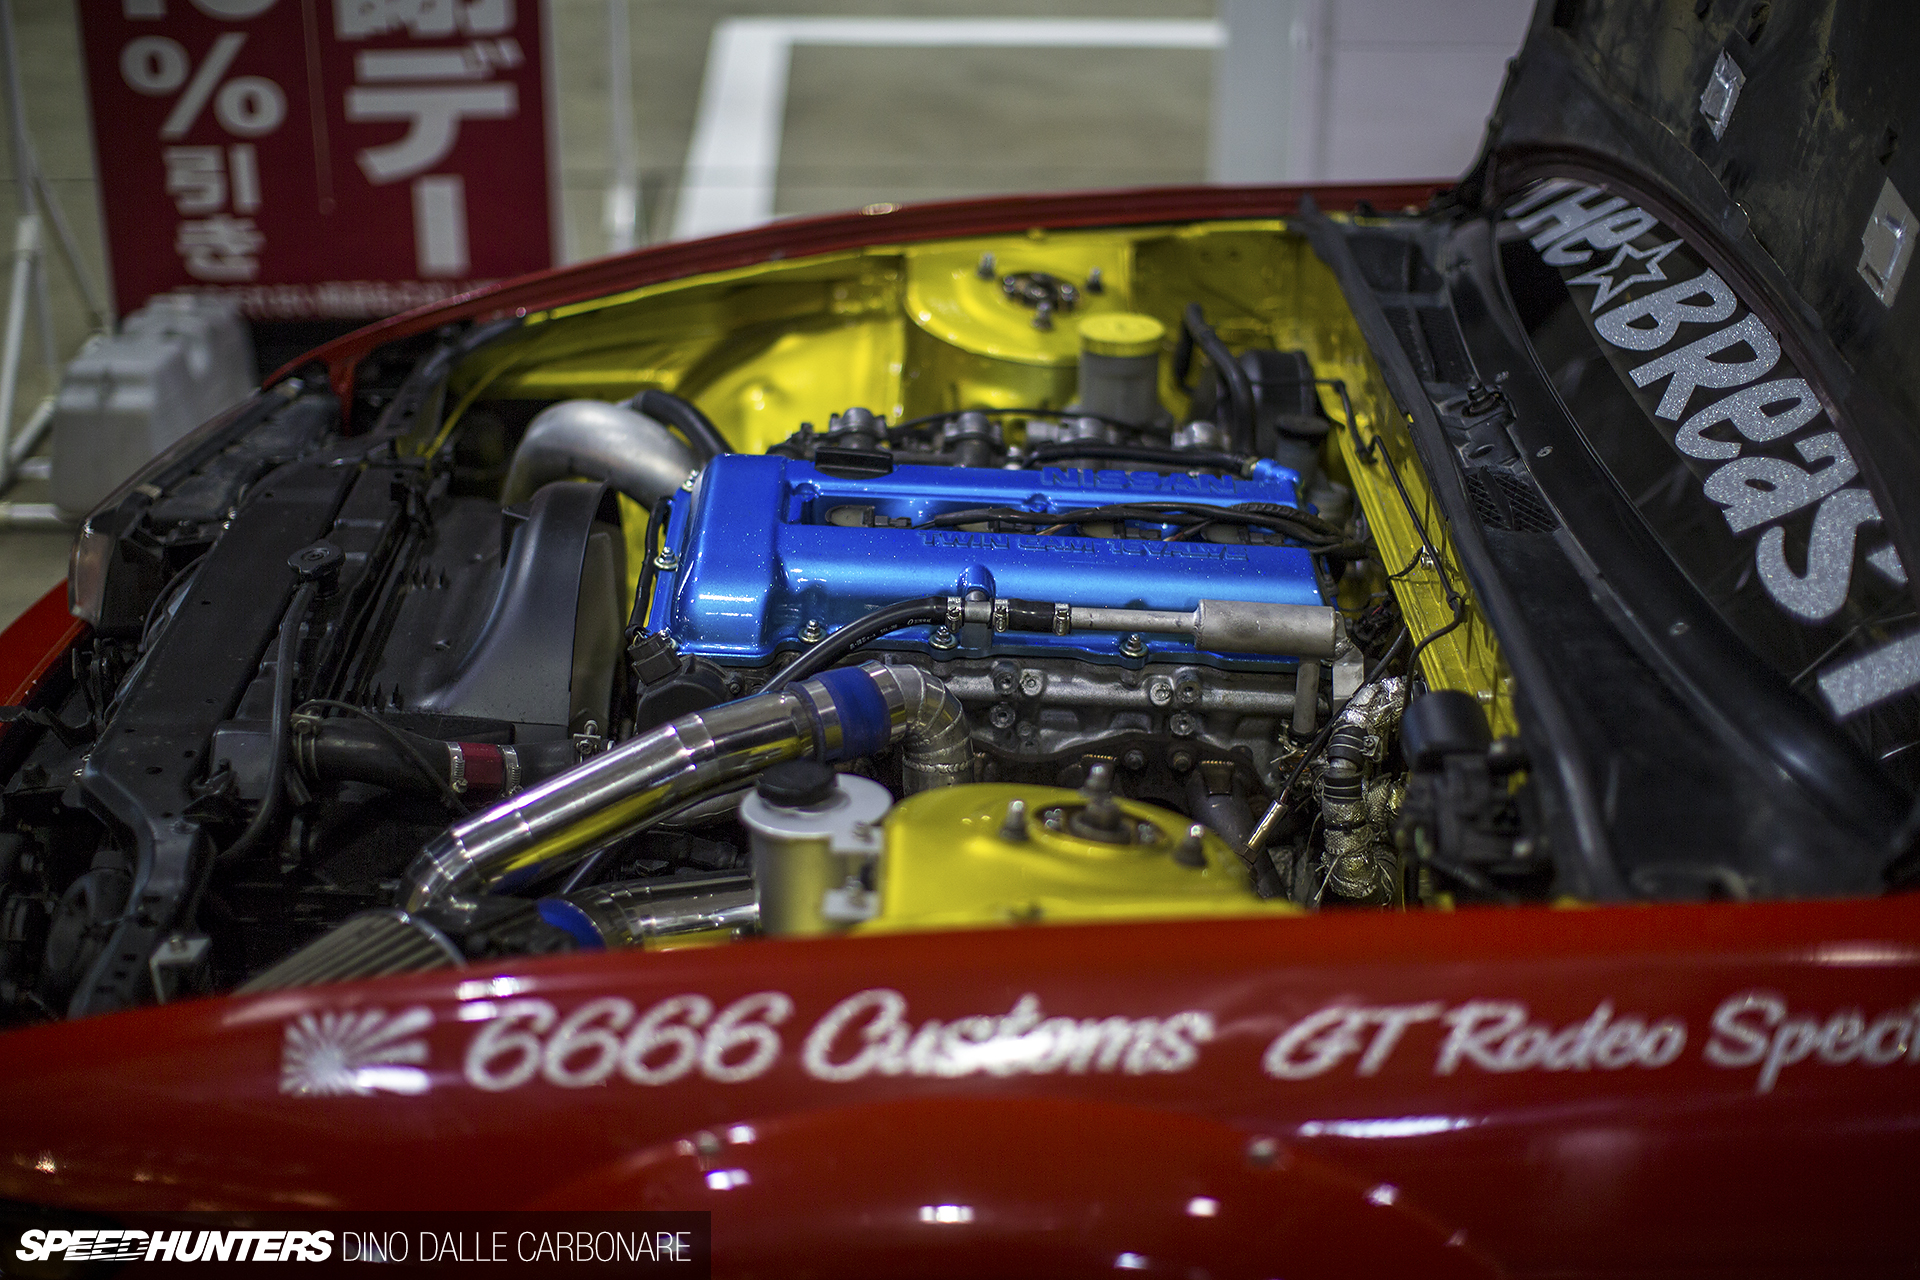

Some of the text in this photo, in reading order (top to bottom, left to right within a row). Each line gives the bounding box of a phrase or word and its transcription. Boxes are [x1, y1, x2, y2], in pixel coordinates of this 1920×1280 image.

[1041, 467, 1237, 494] NISSAN
[918, 531, 1009, 550] TWIN
[1017, 533, 1097, 554] CAM
[464, 992, 793, 1092] 6666
[803, 988, 1213, 1081] Customs
[1264, 1000, 1441, 1080] GT
[1434, 1000, 1688, 1075] Rodeo
